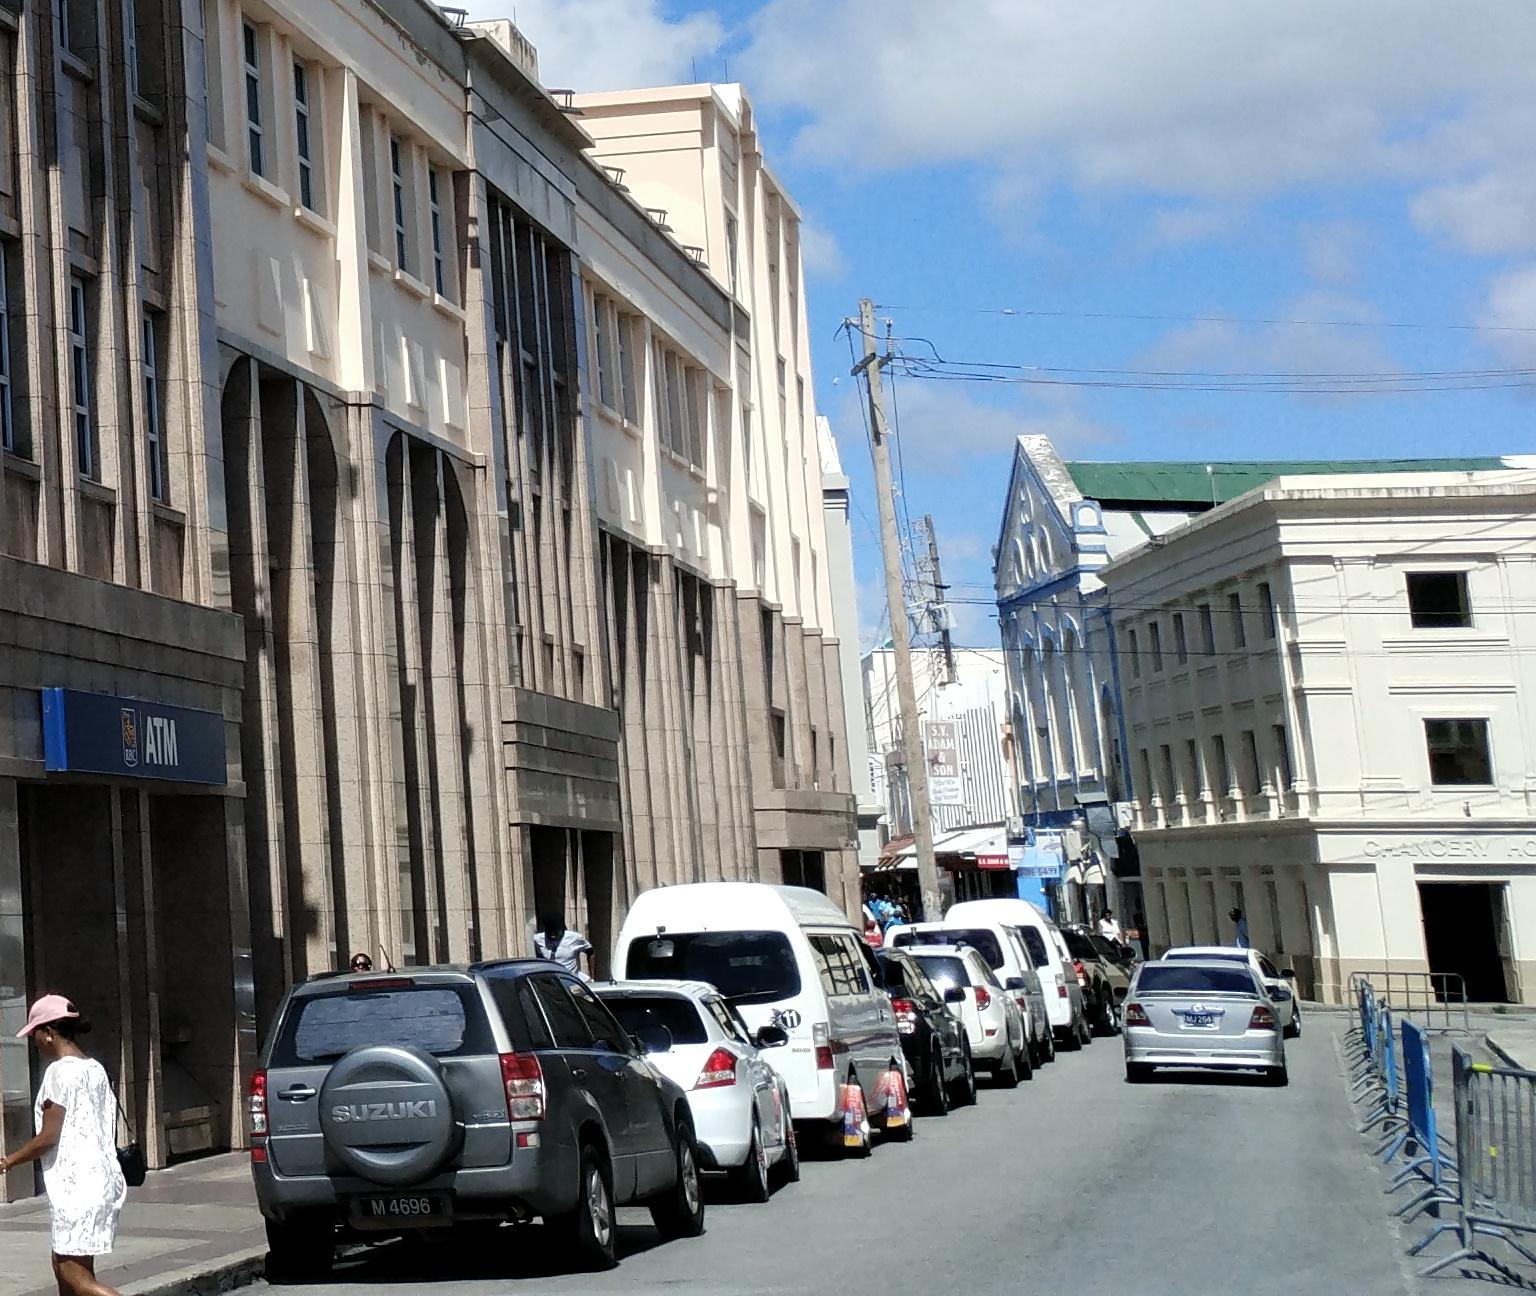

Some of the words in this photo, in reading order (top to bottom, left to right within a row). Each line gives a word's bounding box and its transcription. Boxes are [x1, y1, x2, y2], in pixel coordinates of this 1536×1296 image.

[145, 715, 179, 766] ATM
[125, 748, 136, 762] RBC
[933, 765, 954, 776] SON
[782, 1007, 799, 1024] 11
[331, 1100, 438, 1124] SUZUKI
[371, 1199, 386, 1217] M
[389, 1197, 432, 1216] 4696
